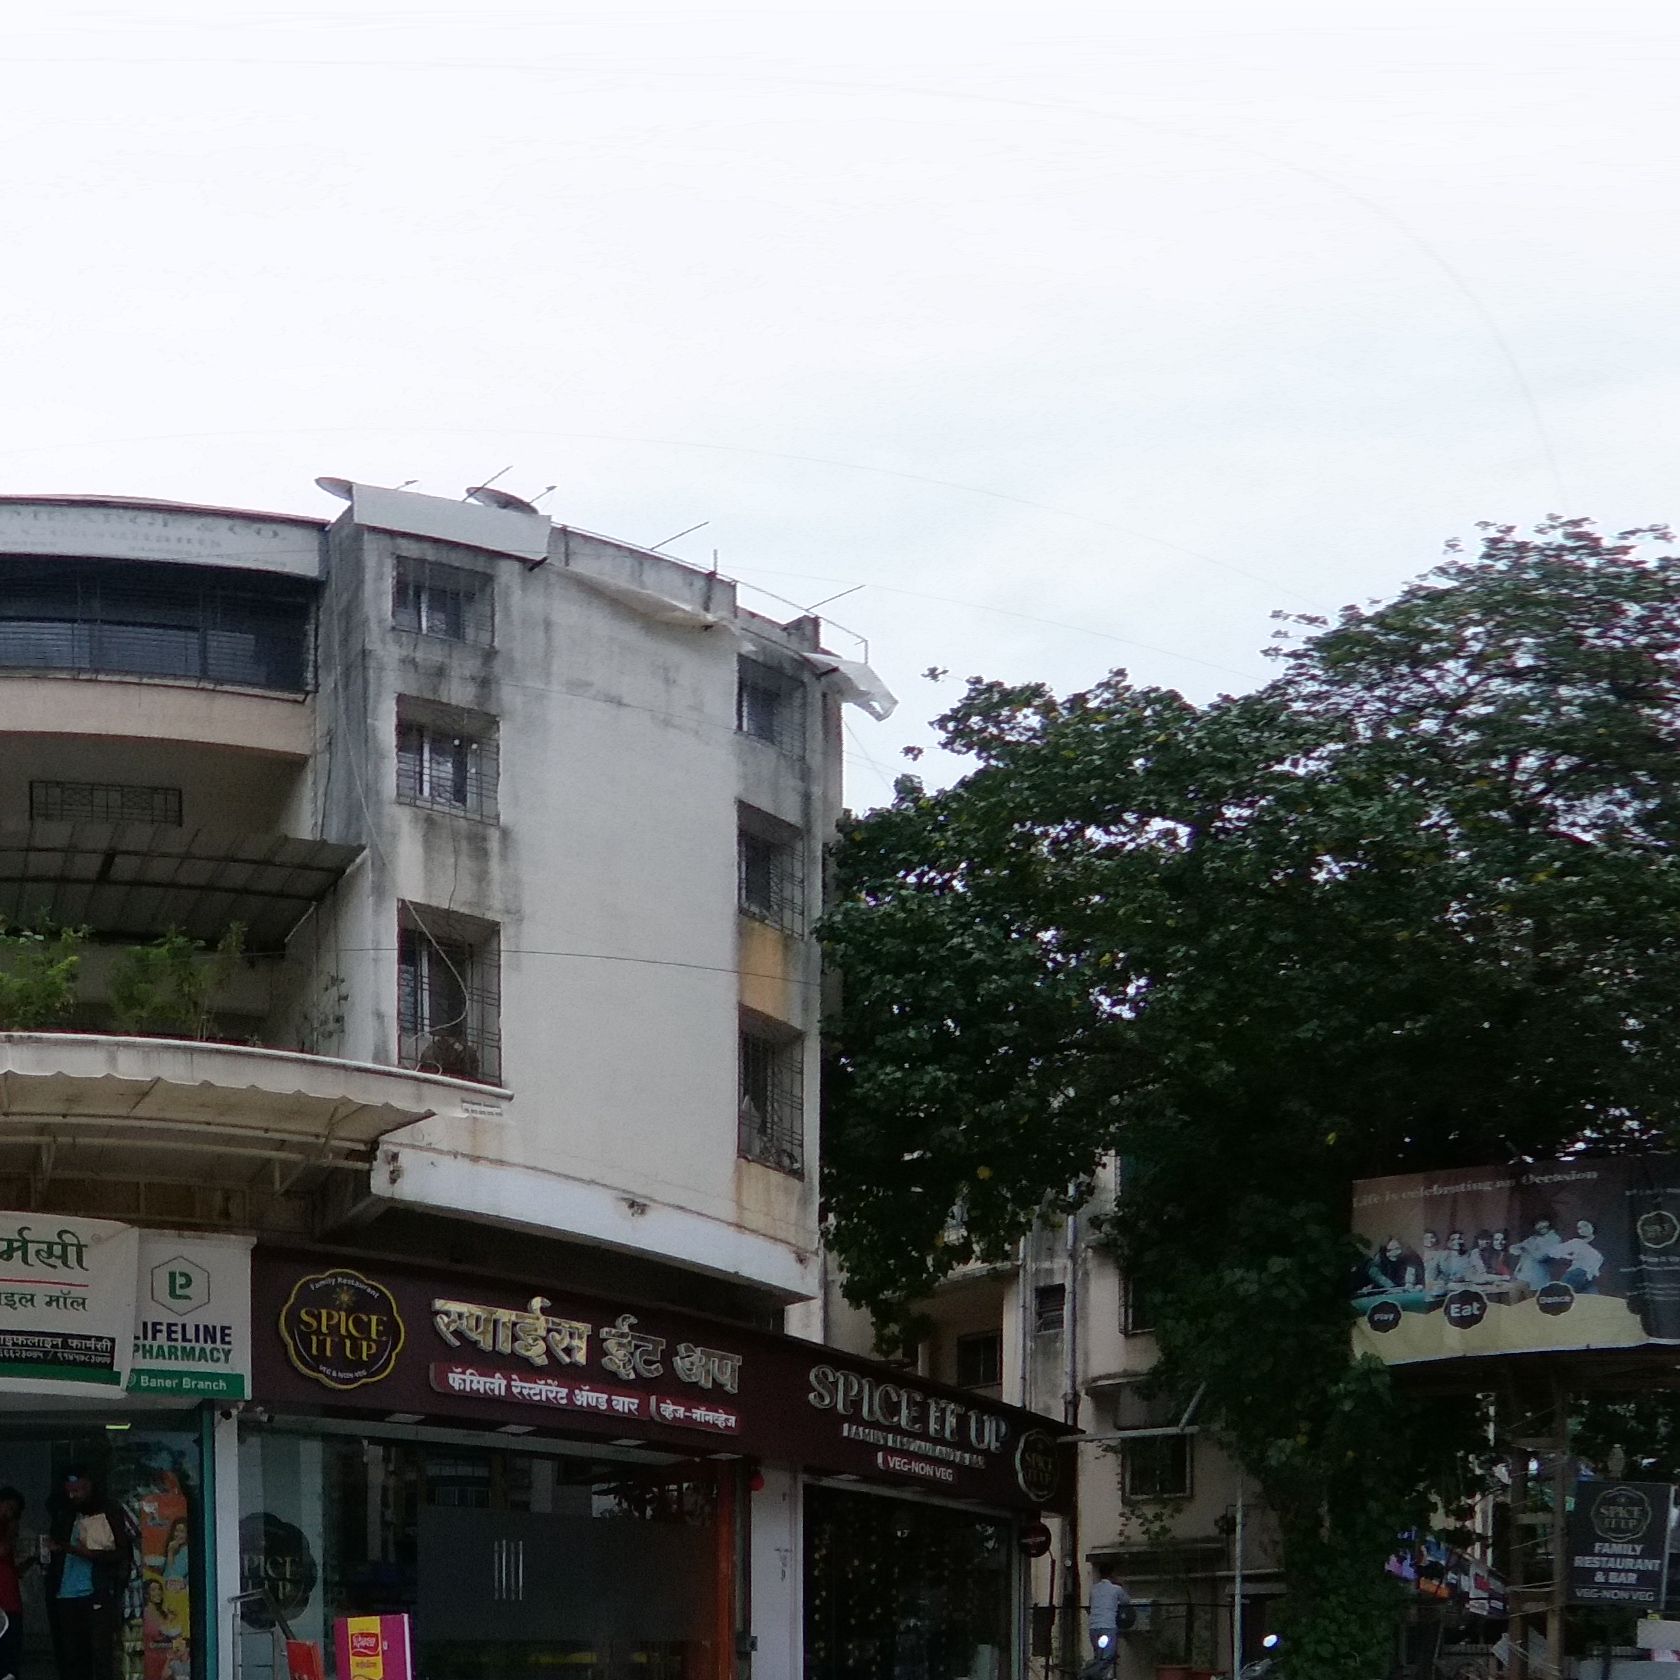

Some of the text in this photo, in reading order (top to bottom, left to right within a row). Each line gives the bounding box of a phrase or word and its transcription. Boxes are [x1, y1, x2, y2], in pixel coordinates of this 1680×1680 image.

[44, 1288, 87, 1312] मॉल
[1449, 1301, 1480, 1318] Eat
[300, 1308, 388, 1340] SPICE
[310, 1335, 377, 1361] IT UP
[140, 1375, 227, 1391] Baner Branch
[448, 1367, 507, 1397] फॅमिली
[611, 1395, 639, 1415] बार
[808, 1364, 1009, 1454] SPICE IT UP
[888, 1455, 954, 1482] VEG-NON VEG
[1593, 1542, 1644, 1556] FAMILY
[1573, 1555, 1661, 1571] RESTAURANT
[1593, 1571, 1638, 1584] & BAR
[1575, 1588, 1655, 1601] VEG-NON VEG
